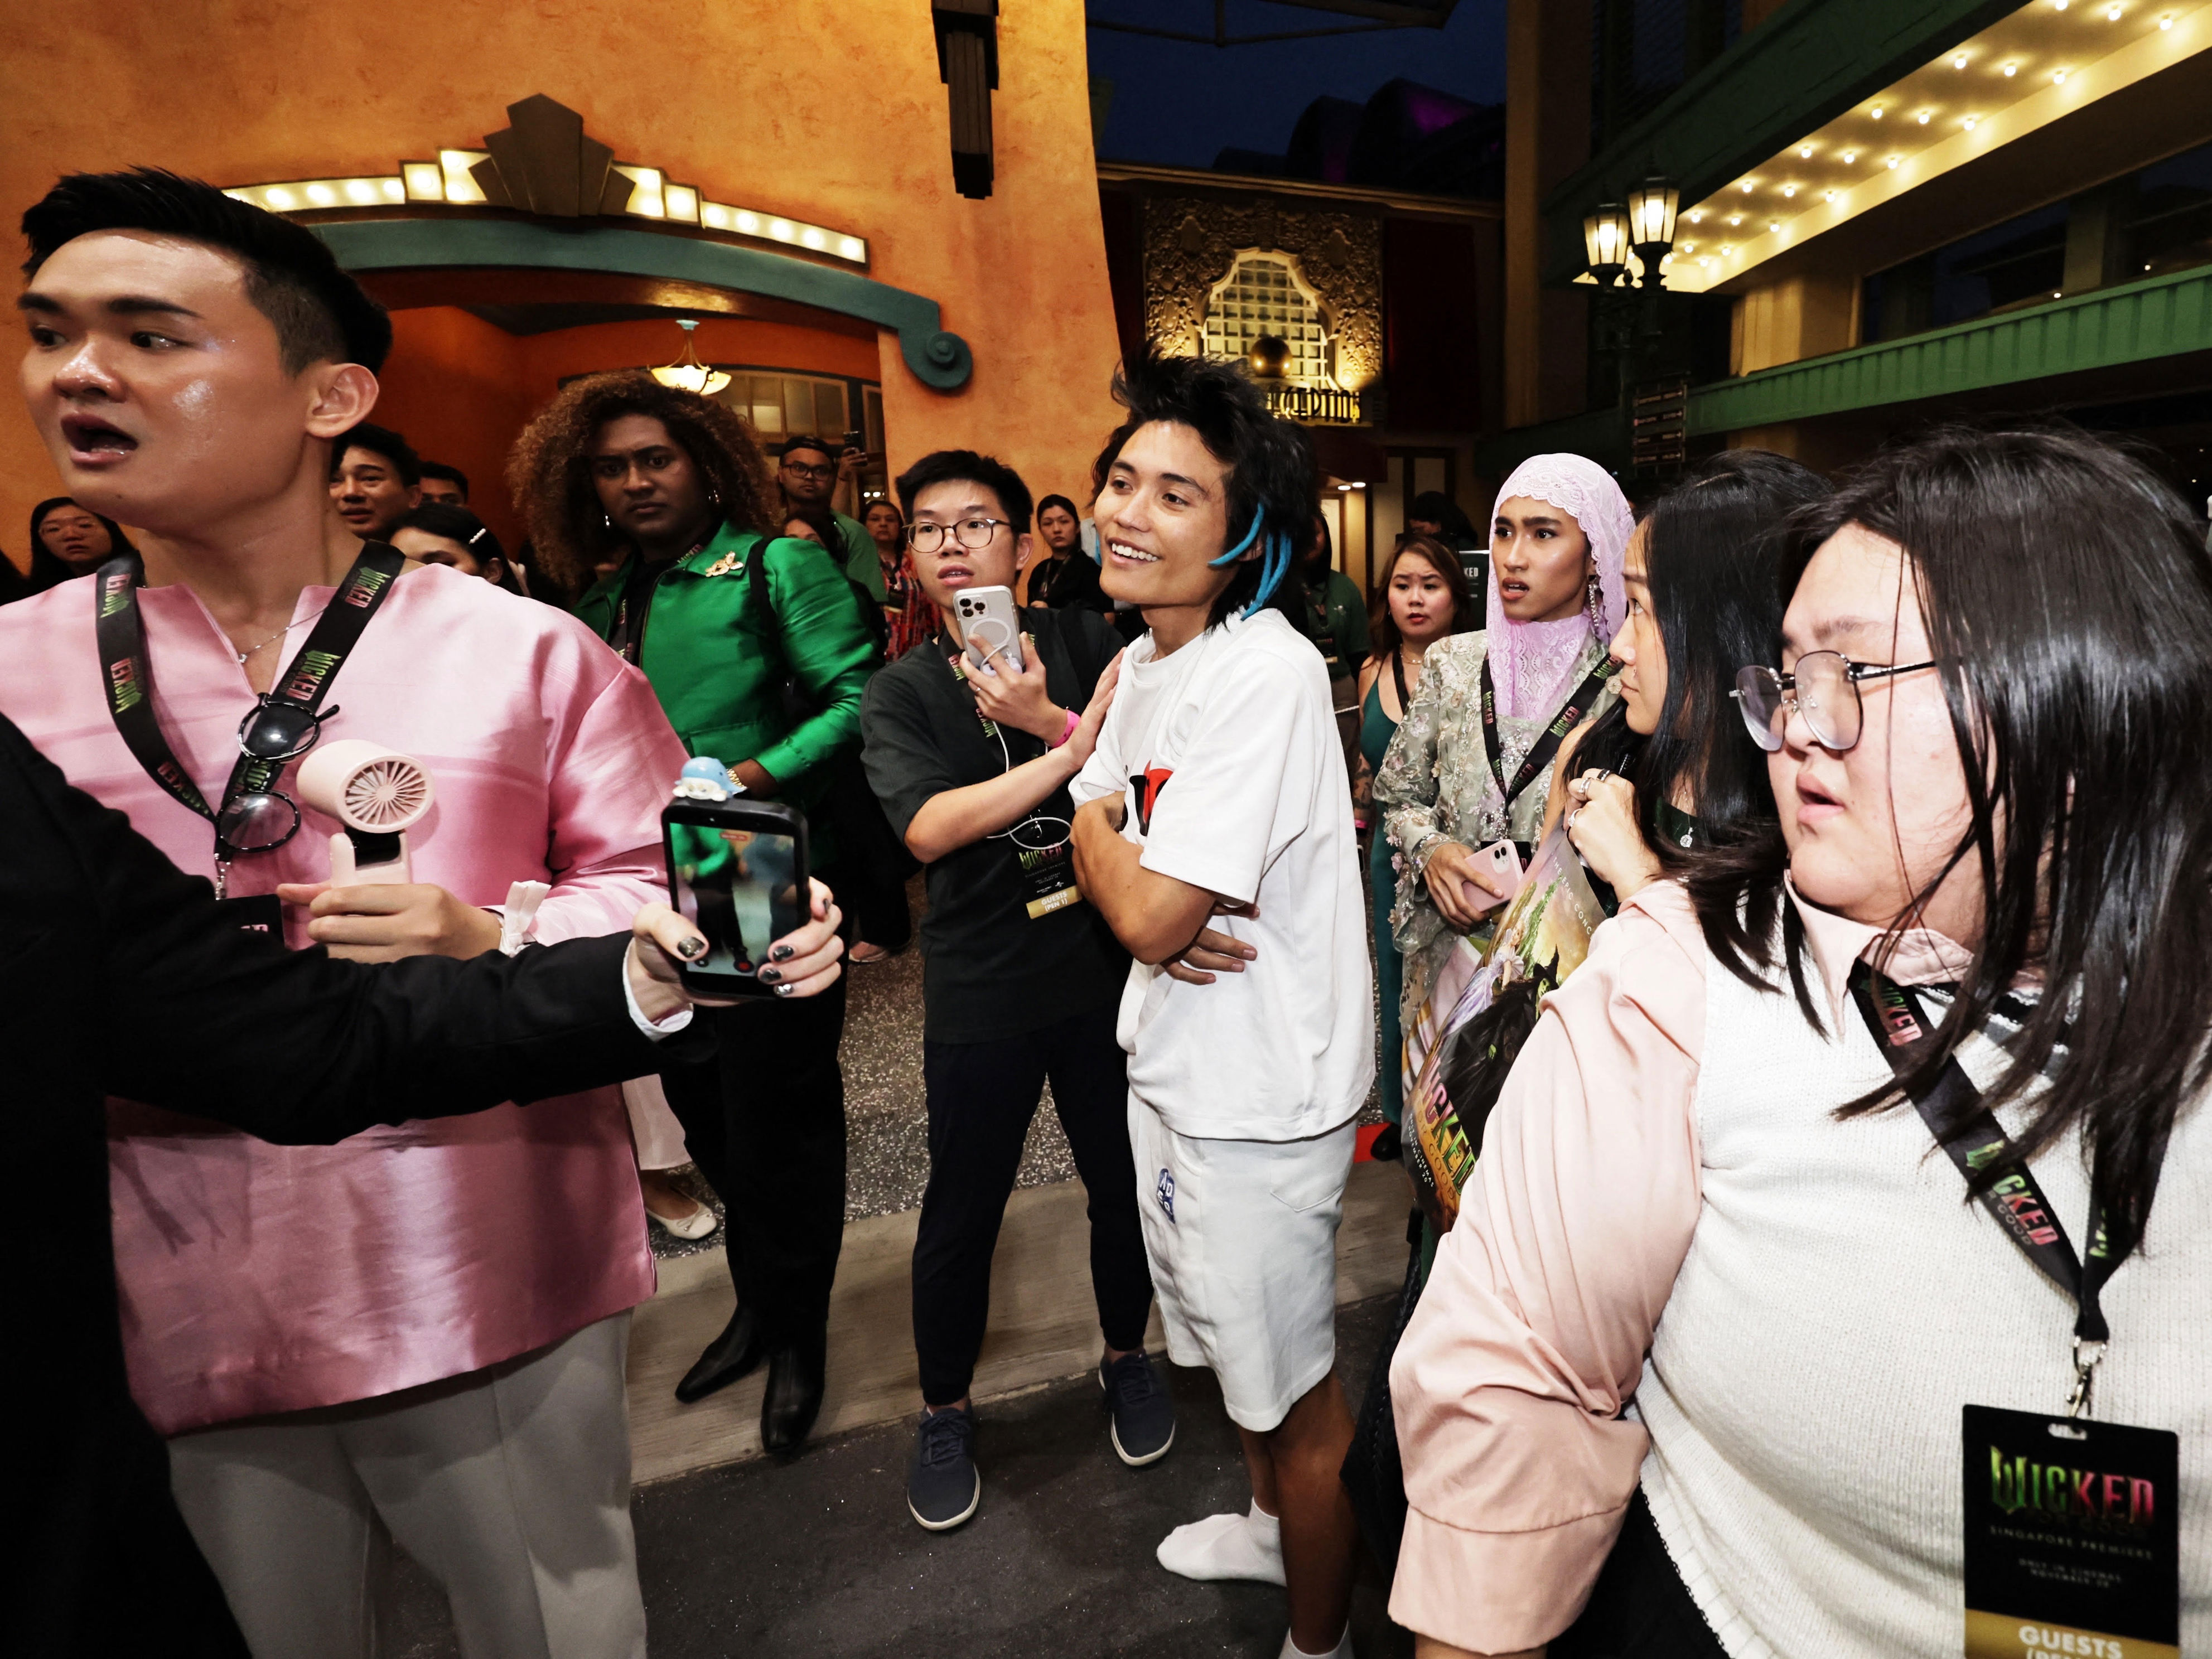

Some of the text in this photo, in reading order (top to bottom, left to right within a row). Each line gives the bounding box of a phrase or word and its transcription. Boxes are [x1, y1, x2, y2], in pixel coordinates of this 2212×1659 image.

[100, 573, 131, 618] WICKED
[345, 567, 391, 608] WICKED
[110, 657, 142, 714] WICKED
[286, 650, 342, 701] WICKED
[1593, 656, 1619, 679] WICKE
[1482, 690, 1494, 724] WICKED
[1549, 705, 1580, 738] WICKED
[1041, 891, 1068, 905] GUESTS
[1045, 901, 1060, 912] (PEN
[1553, 856, 1592, 935] THE EPIC CONC
[1408, 1125, 1428, 1183] NOVEMBER 20
[1417, 1149, 1435, 1187] CINEMAS
[1428, 1143, 1455, 1199] GOOD
[1966, 1139, 2059, 1245] WCKED
[1997, 1204, 2032, 1245] GOOD
[1990, 1445, 2156, 1527] WICKED
[1990, 1525, 2073, 1547] SINGAPORE
[2081, 1540, 2152, 1560] PREMIERE
[2018, 1625, 2123, 1659] GUESTS
